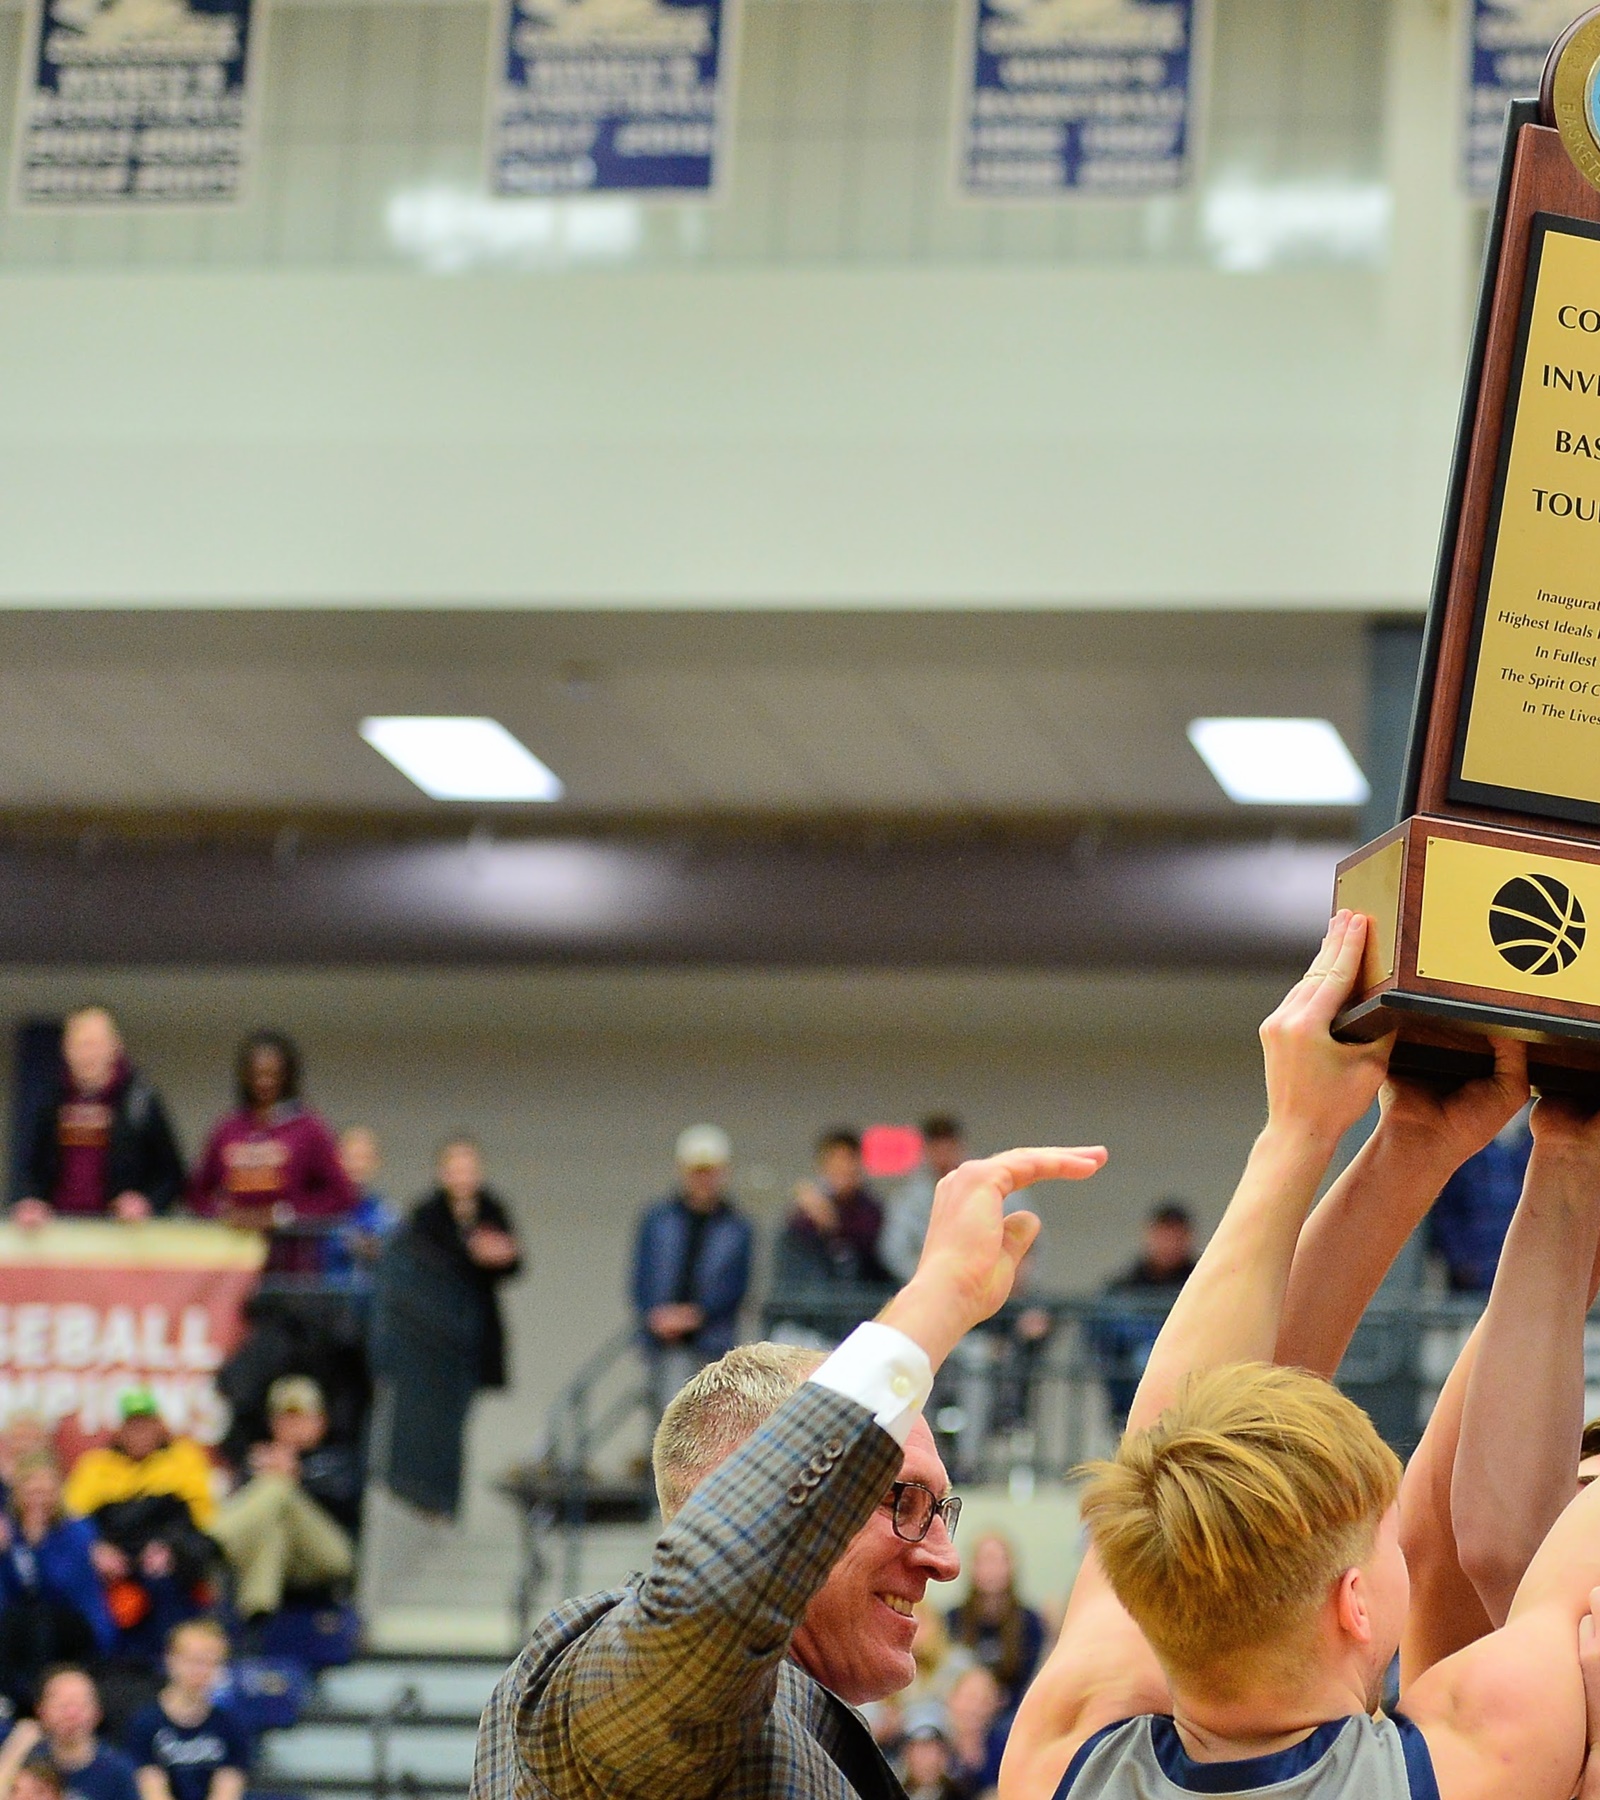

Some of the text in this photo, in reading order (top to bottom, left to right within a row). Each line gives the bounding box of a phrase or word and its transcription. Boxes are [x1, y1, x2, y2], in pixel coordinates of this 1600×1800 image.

[1498, 611, 1549, 630] Highest
[1554, 620, 1592, 638] Ideals
[1536, 646, 1548, 658] In
[1553, 649, 1596, 667] Fullest
[1500, 668, 1524, 682] The
[1528, 674, 1564, 690] Spirit
[1570, 680, 1589, 694] Of
[1522, 701, 1536, 714] In
[1541, 704, 1565, 718] The
